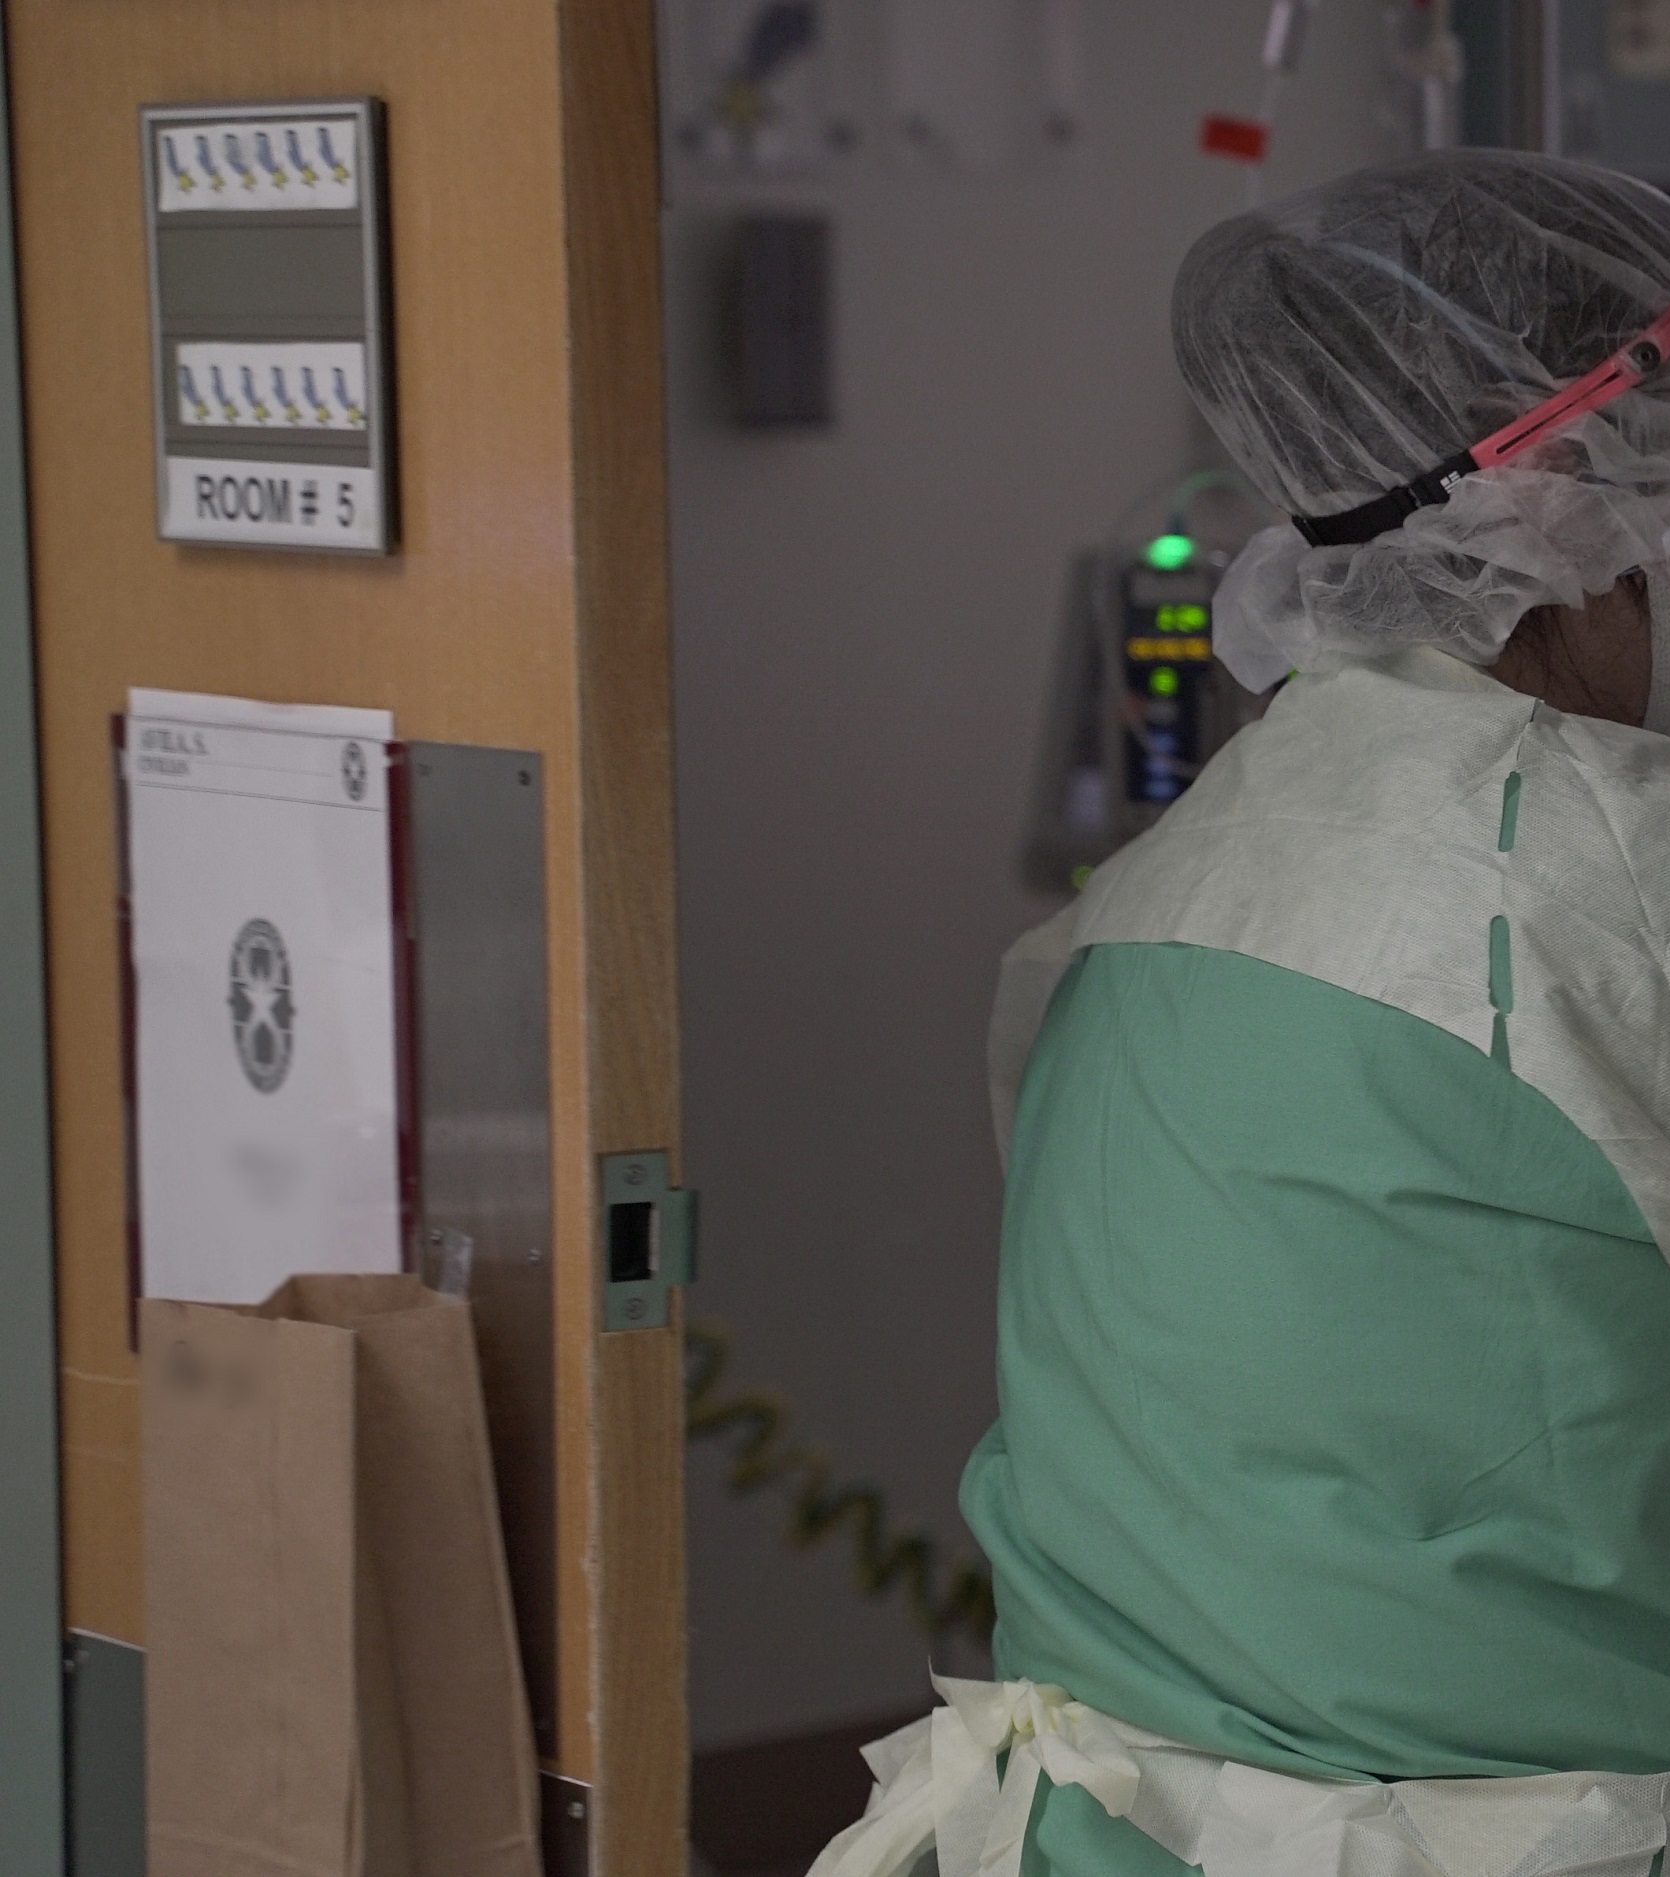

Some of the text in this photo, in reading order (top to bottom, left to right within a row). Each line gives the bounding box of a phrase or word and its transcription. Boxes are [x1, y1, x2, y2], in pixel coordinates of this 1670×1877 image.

[195, 474, 354, 527] ROOM # 5
